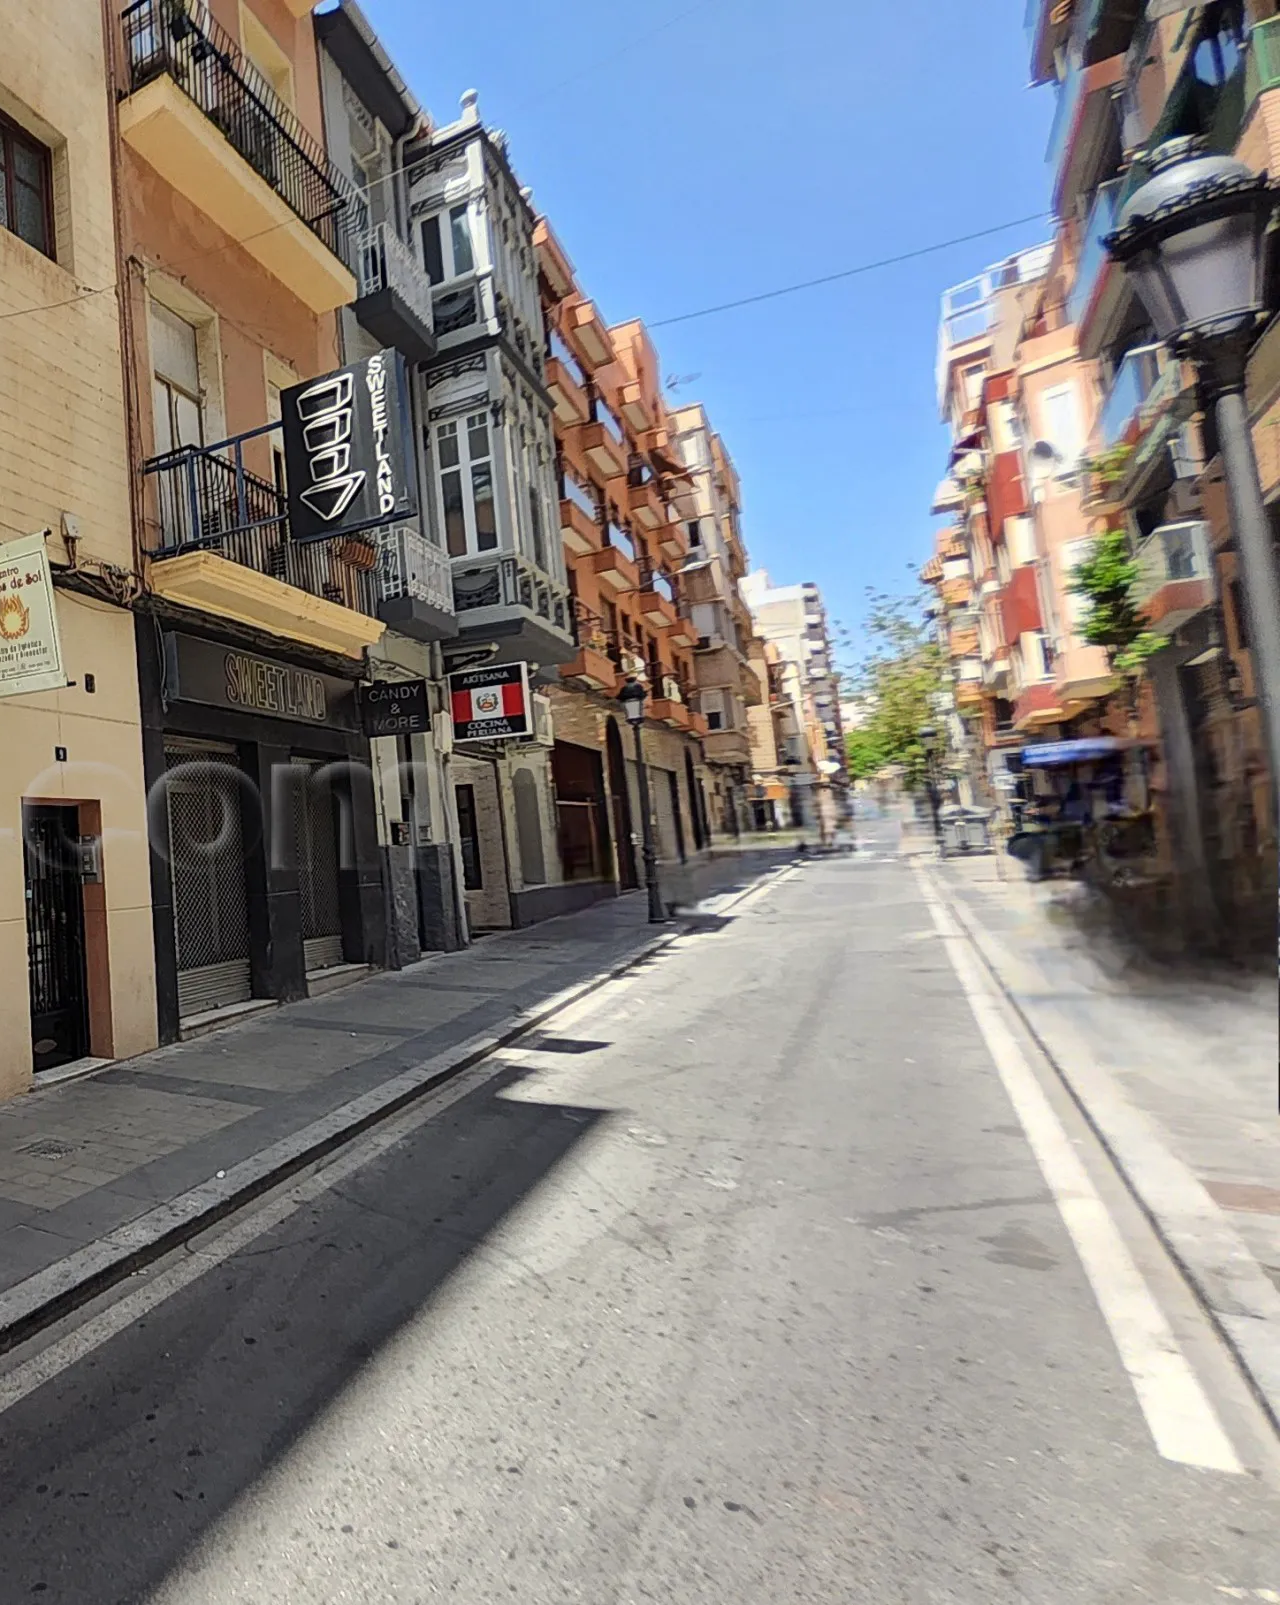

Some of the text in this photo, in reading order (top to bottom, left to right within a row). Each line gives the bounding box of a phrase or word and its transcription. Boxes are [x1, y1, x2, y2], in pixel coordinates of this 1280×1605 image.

[366, 355, 395, 516] SWEETLAND
[10, 577, 24, 589] de
[25, 570, 42, 585] Sol
[462, 671, 510, 684] ARTESANA
[225, 653, 326, 720] SWEETLAND
[369, 685, 420, 702] CANDY
[390, 703, 401, 714] &
[373, 715, 420, 731] MORE
[468, 718, 509, 730] COCINA
[467, 726, 512, 738] PERUANA
